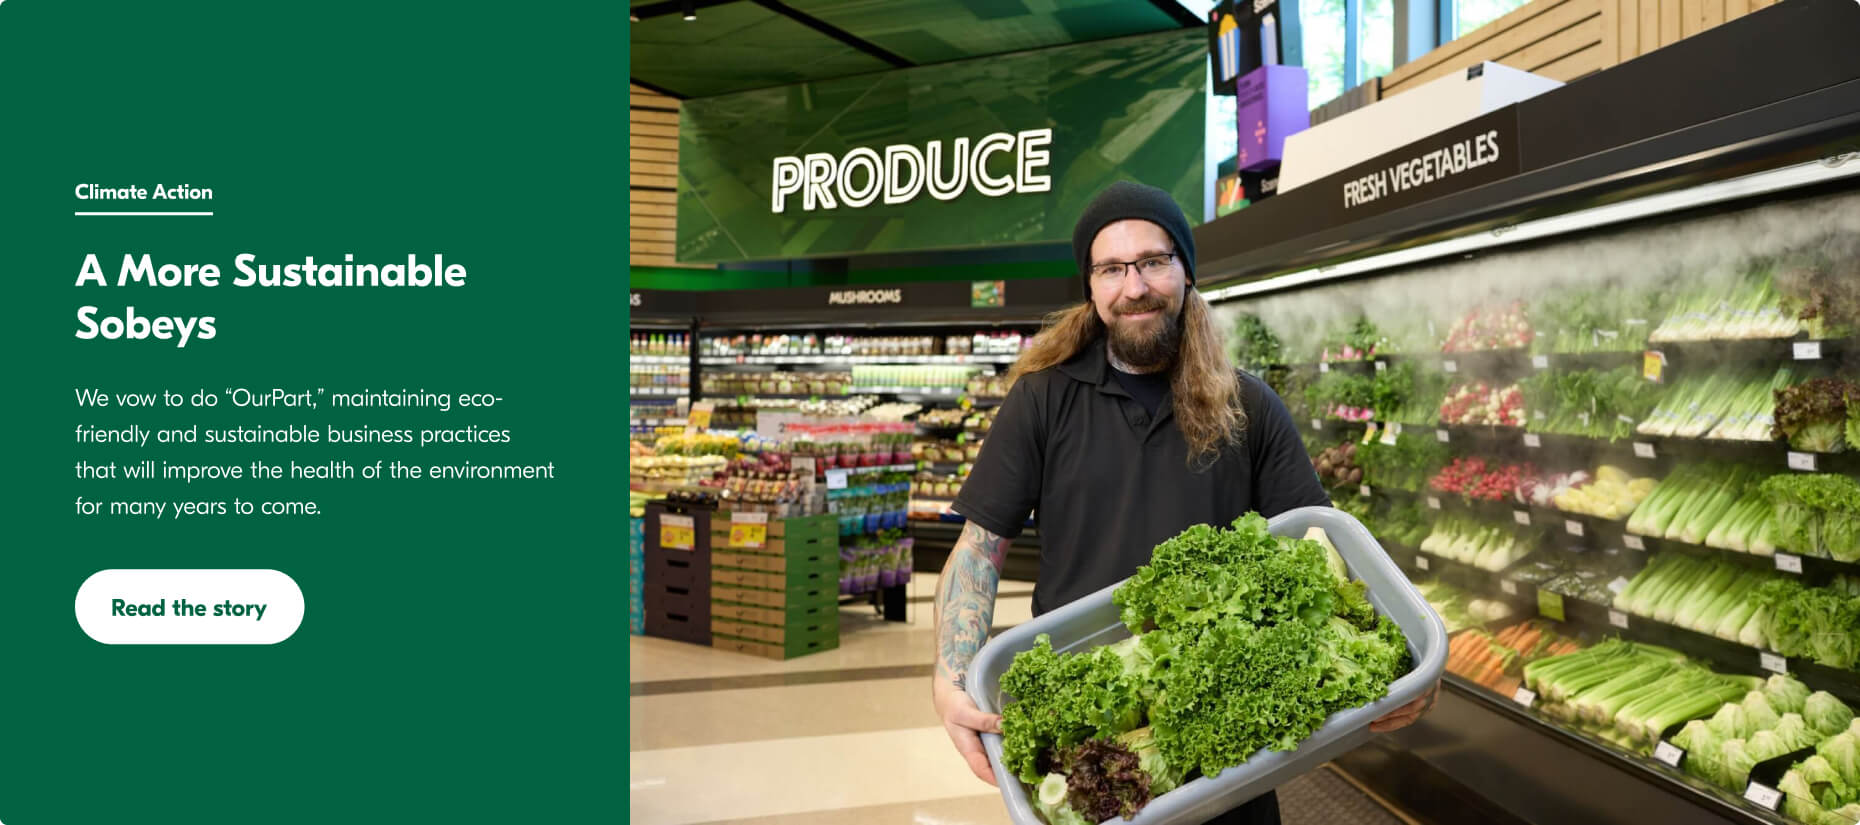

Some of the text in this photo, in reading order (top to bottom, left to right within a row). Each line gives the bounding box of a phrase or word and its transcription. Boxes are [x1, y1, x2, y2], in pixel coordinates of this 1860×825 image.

[772, 128, 1052, 213] PRODUCE
[1344, 130, 1500, 208] FRESH VEGETABLES
[828, 289, 902, 305] MUSHROOMS
